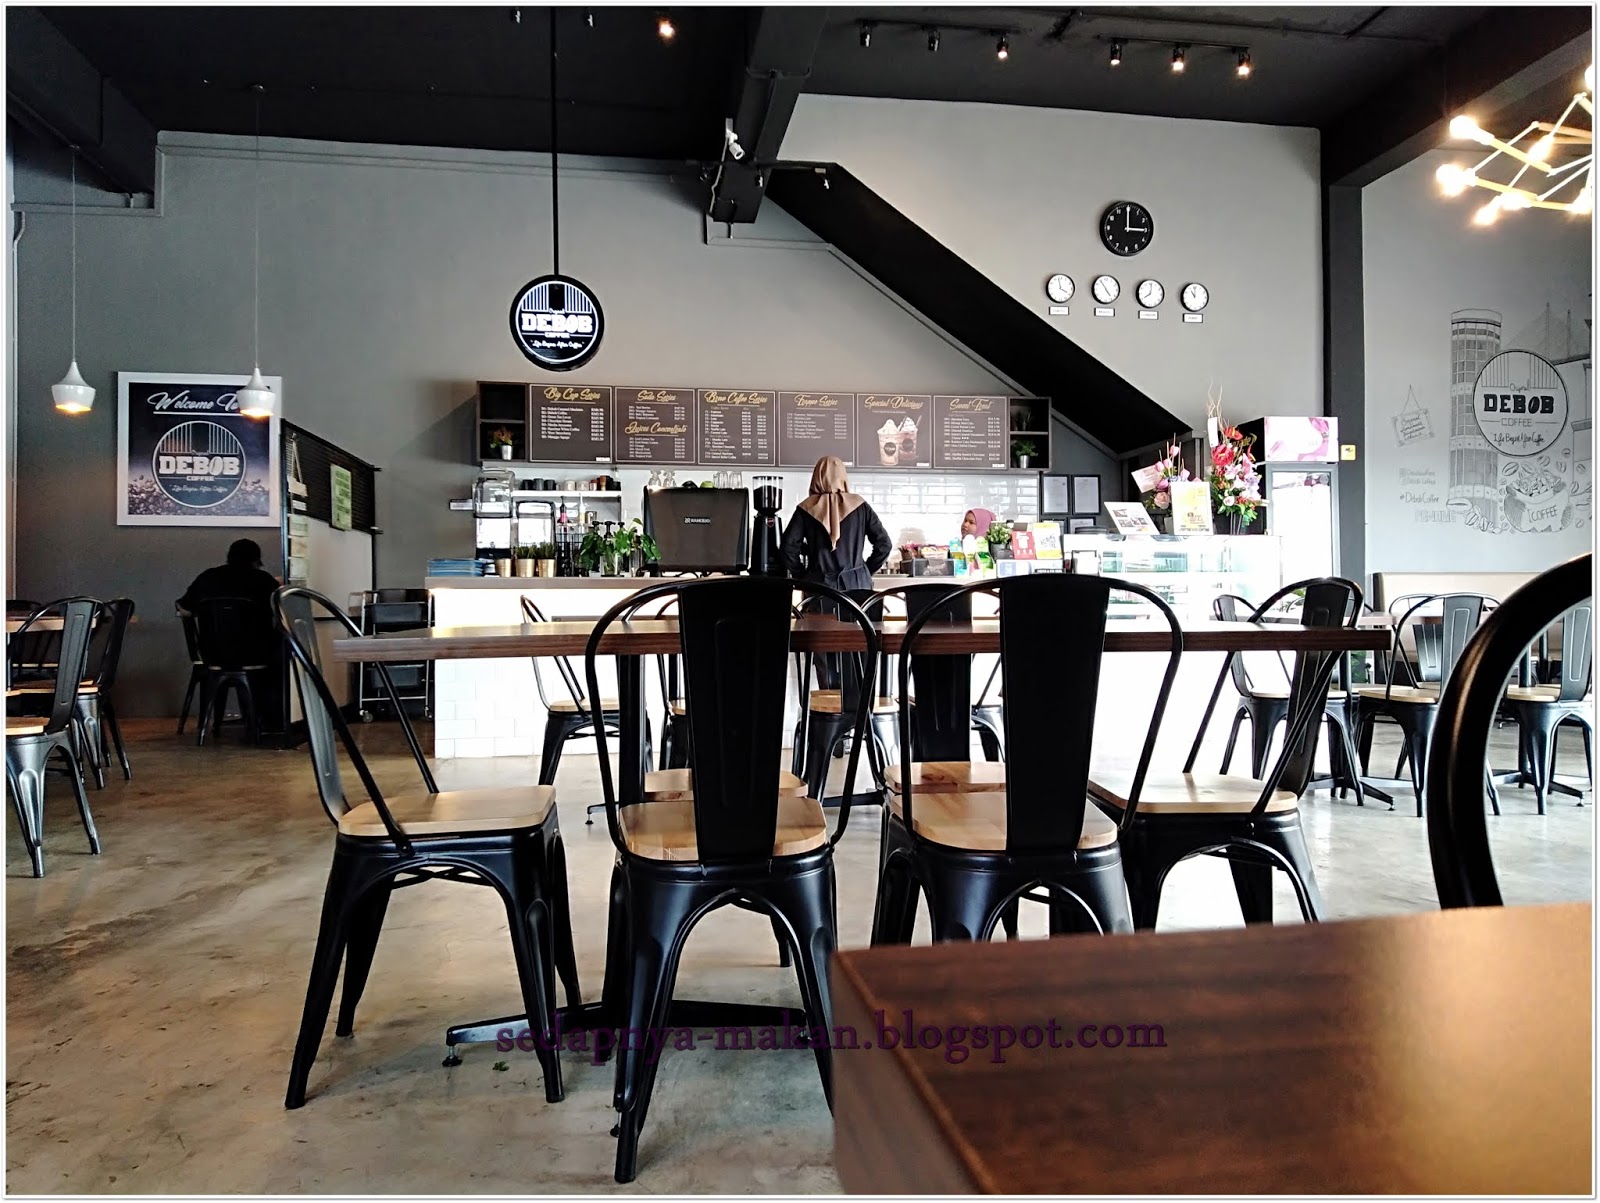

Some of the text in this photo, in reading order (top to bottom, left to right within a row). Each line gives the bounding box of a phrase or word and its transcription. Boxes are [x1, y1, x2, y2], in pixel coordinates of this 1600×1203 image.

[521, 313, 593, 333] DEBOB
[147, 390, 214, 411] Welcome
[580, 388, 600, 401] Series
[656, 391, 676, 402] Series
[728, 392, 747, 405] Coffee
[748, 392, 768, 404] Series
[819, 396, 838, 407] Series
[864, 396, 890, 410] Special
[1483, 394, 1554, 414] DEBOB
[1501, 417, 1533, 427] COFFEE
[159, 455, 240, 476] DEBOB
[1531, 505, 1558, 521] COFFEE
